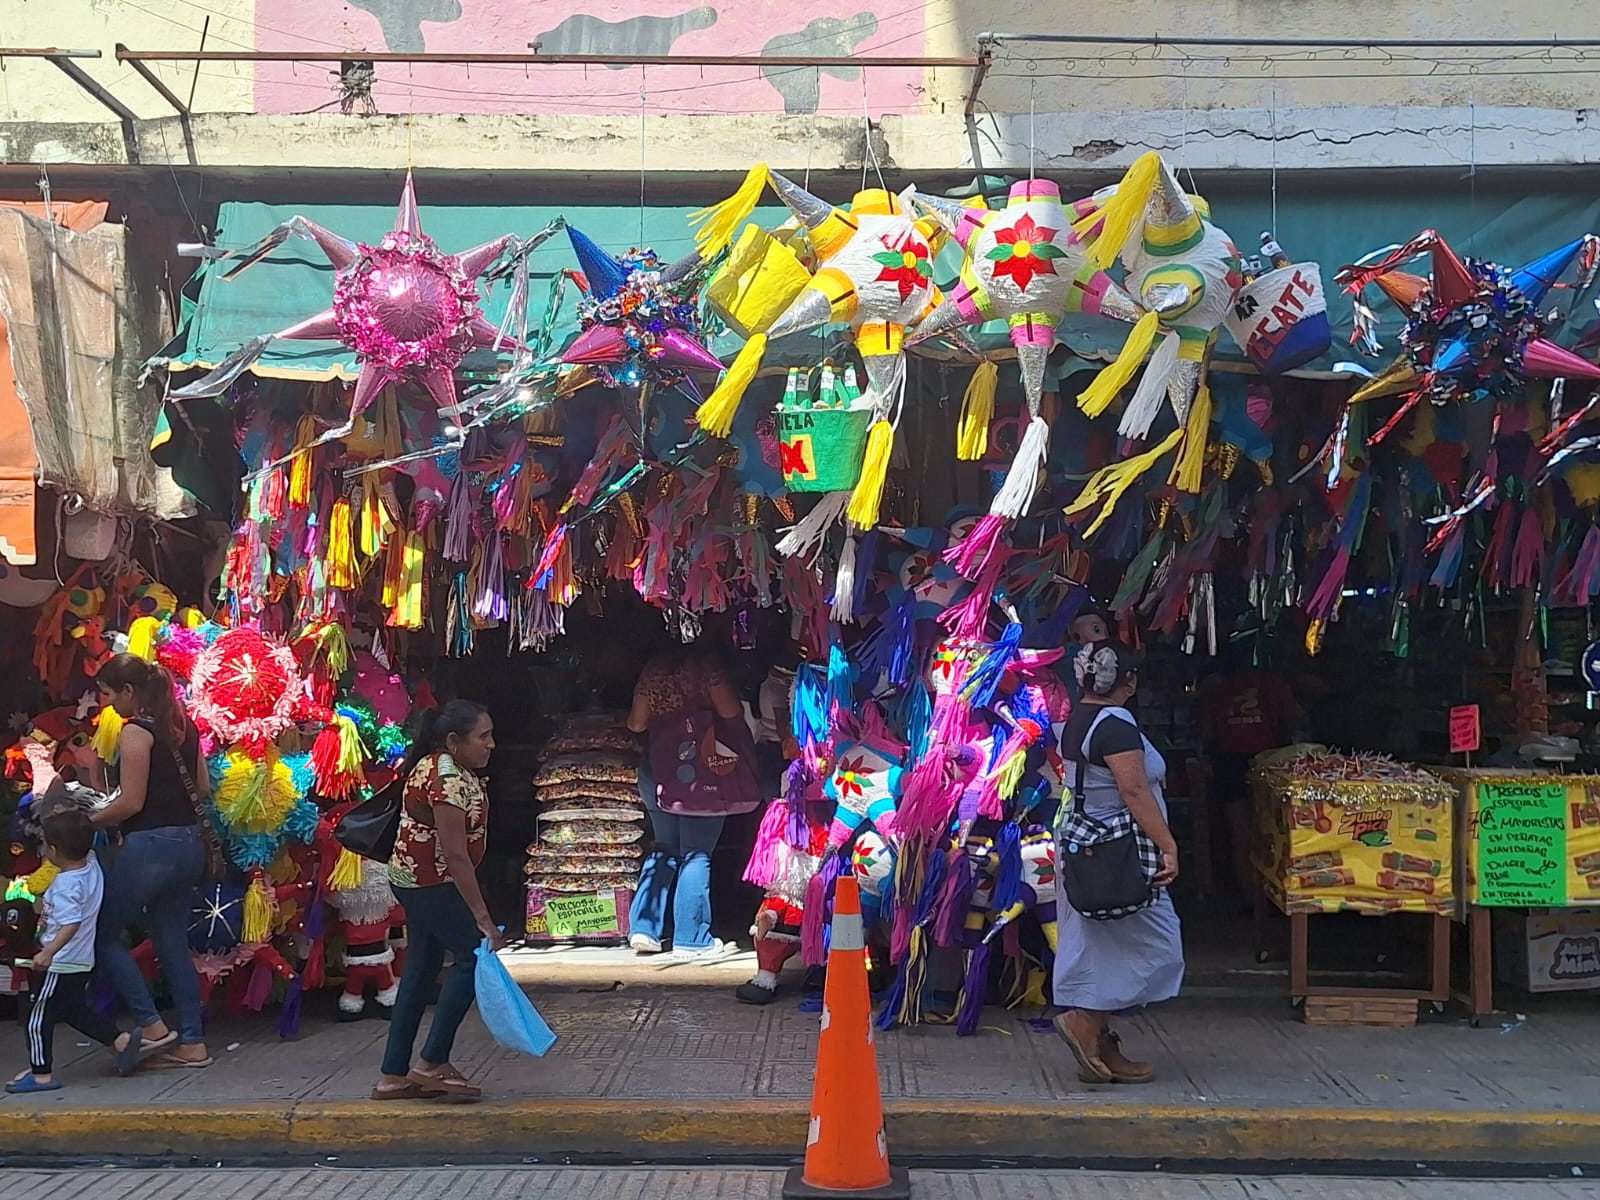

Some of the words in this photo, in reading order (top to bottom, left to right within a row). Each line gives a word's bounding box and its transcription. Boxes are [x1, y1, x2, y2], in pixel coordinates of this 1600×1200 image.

[1246, 270, 1315, 371] TECATE
[1485, 784, 1542, 799] PRECIOS
[1338, 807, 1393, 835] Zumba
[1501, 816, 1565, 830] MAYORISTAS
[1488, 834, 1503, 843] EN
[1486, 845, 1547, 857] NAVIDEÑAS
[548, 898, 588, 912] PRECIOS
[557, 905, 604, 920] ESPECIALES
